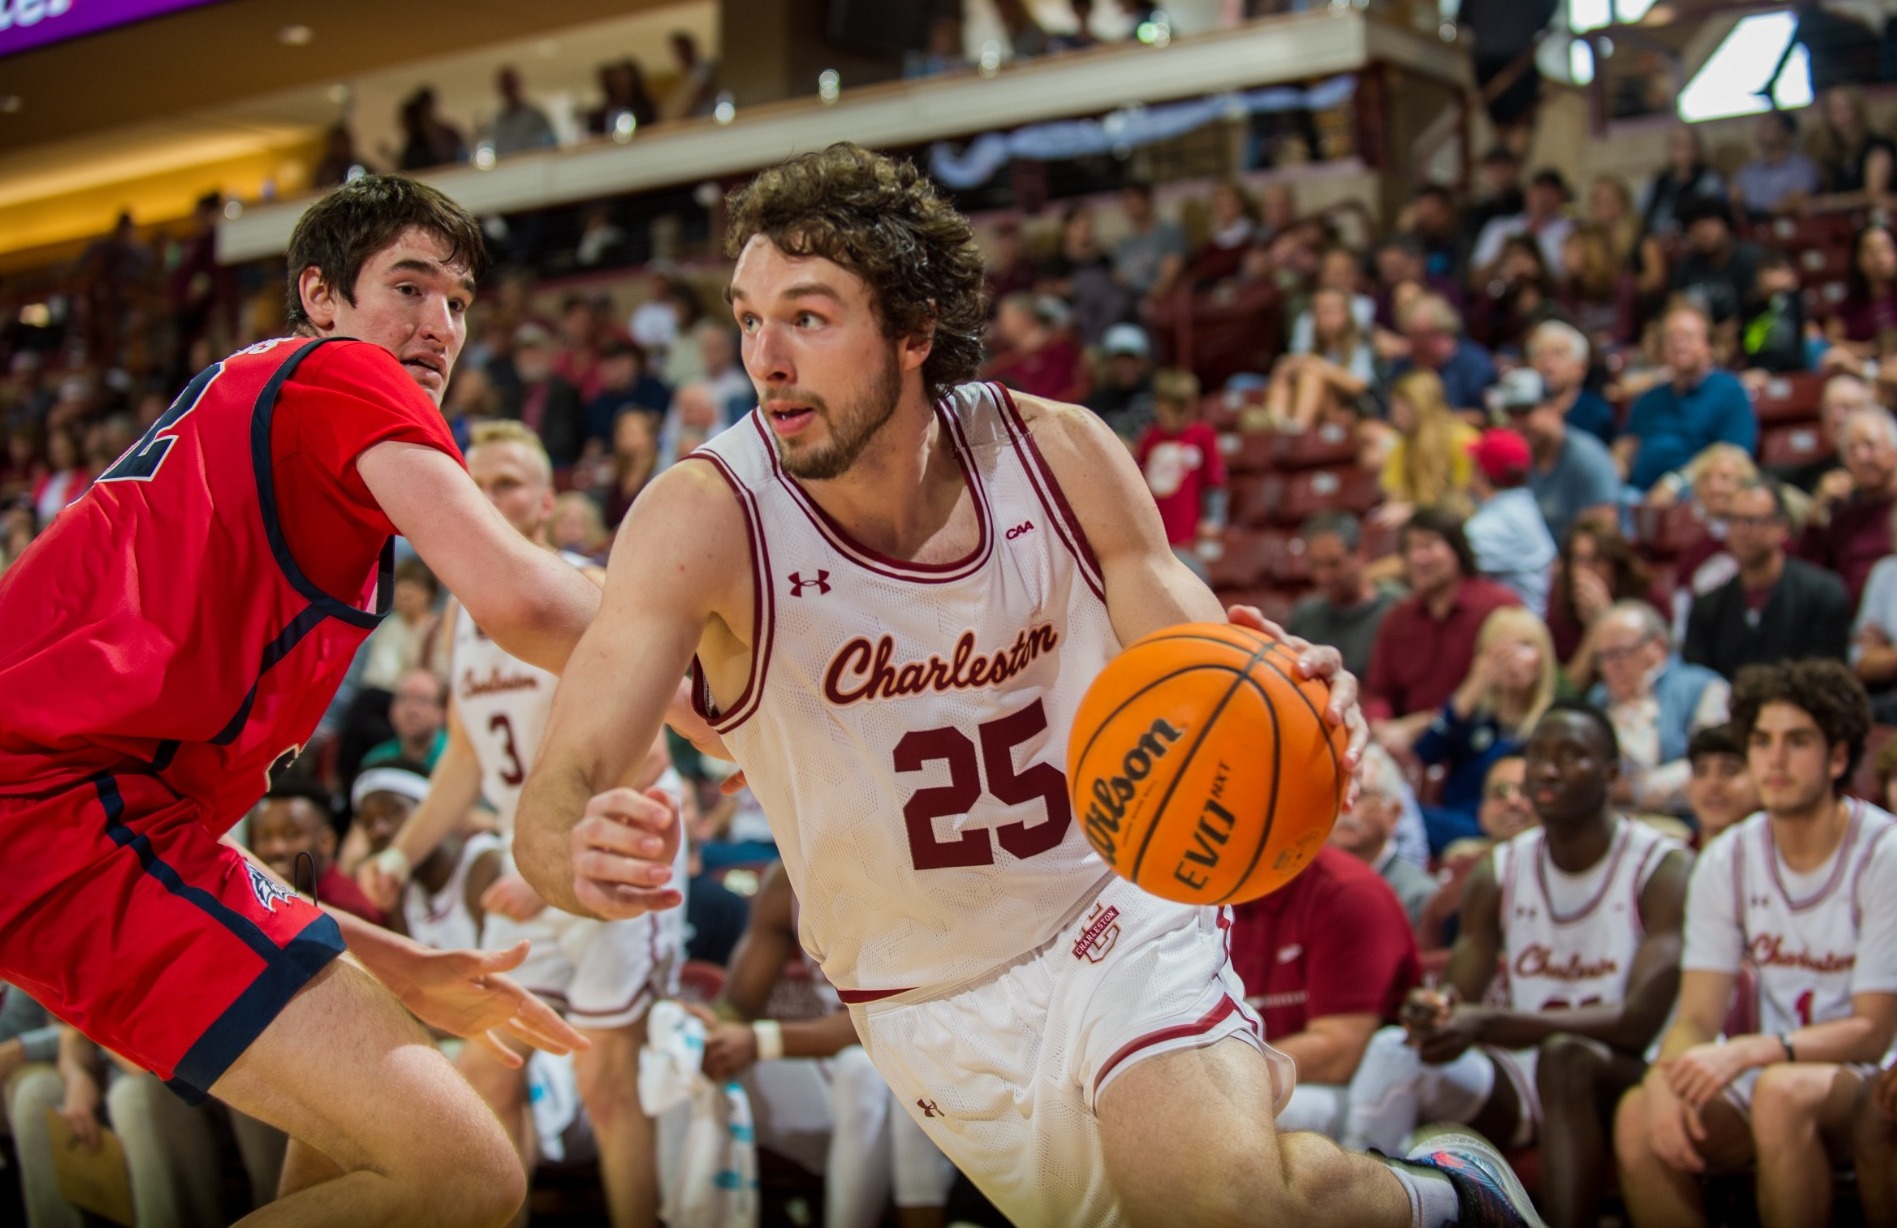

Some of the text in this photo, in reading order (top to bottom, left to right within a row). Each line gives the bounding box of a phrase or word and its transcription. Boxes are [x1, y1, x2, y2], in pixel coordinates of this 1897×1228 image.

[1005, 520, 1035, 540] CAA
[823, 622, 1059, 706] Charleston
[489, 713, 524, 786] 3
[892, 695, 1072, 871] 25
[1075, 909, 1116, 957] CHARLESTON
